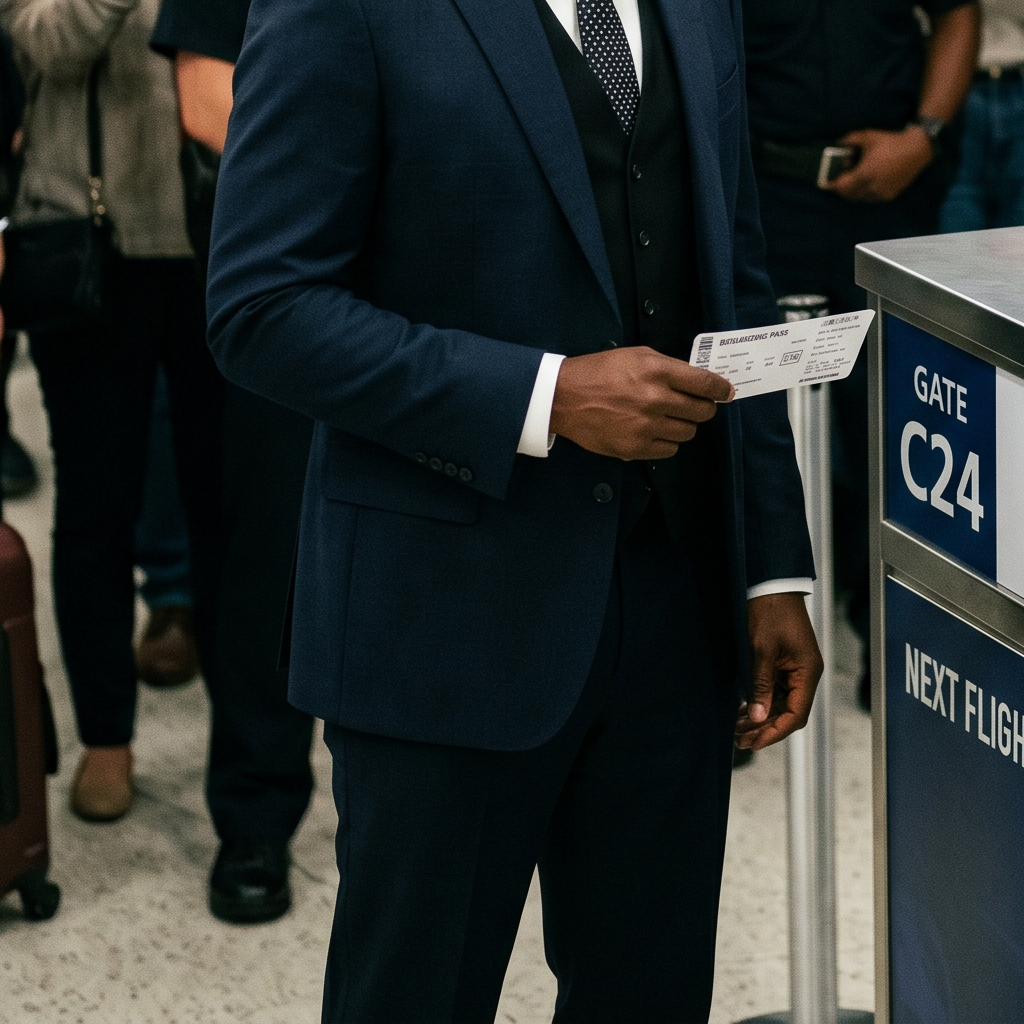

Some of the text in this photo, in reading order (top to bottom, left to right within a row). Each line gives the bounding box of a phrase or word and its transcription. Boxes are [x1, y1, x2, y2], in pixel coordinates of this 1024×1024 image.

[769, 329, 789, 338] PASS
[914, 365, 968, 424] GATE
[900, 420, 984, 533] C24
[905, 642, 959, 724] NEXT
